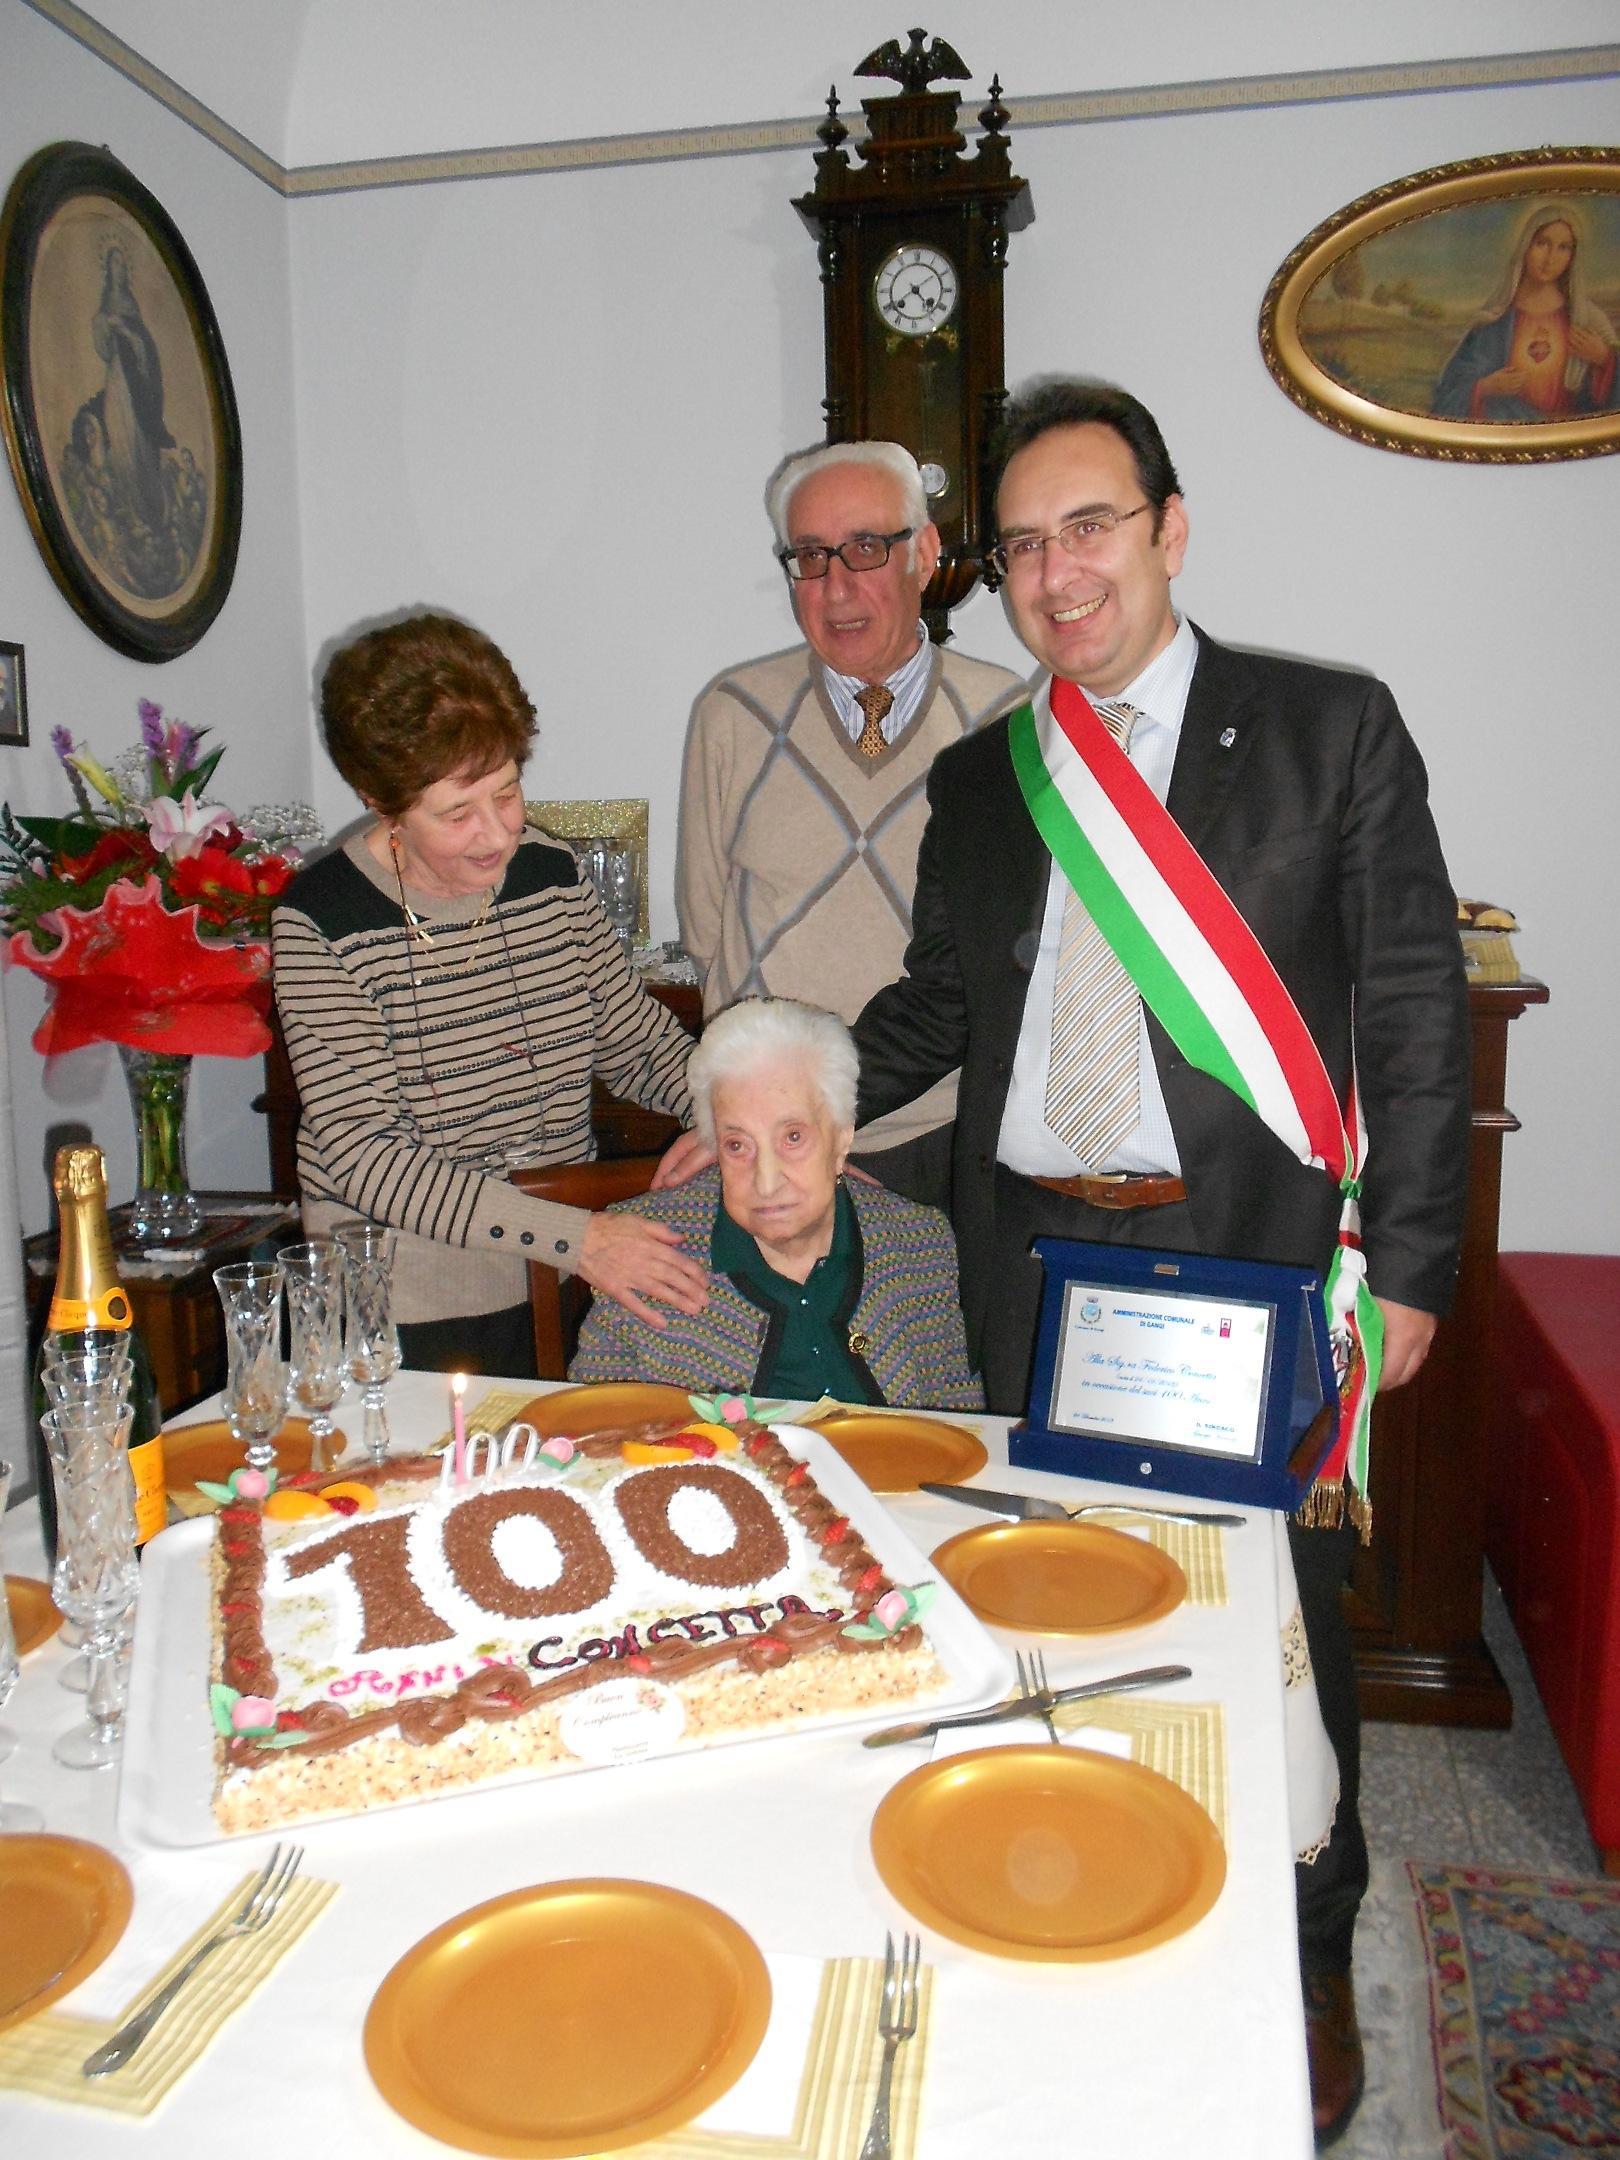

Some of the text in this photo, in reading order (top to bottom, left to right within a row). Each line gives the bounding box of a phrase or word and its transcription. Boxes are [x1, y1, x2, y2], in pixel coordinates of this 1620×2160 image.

[1112, 1308, 1195, 1325] AMMINISTRAZIONE COMUNALE
[284, 1462, 791, 1655] 100
